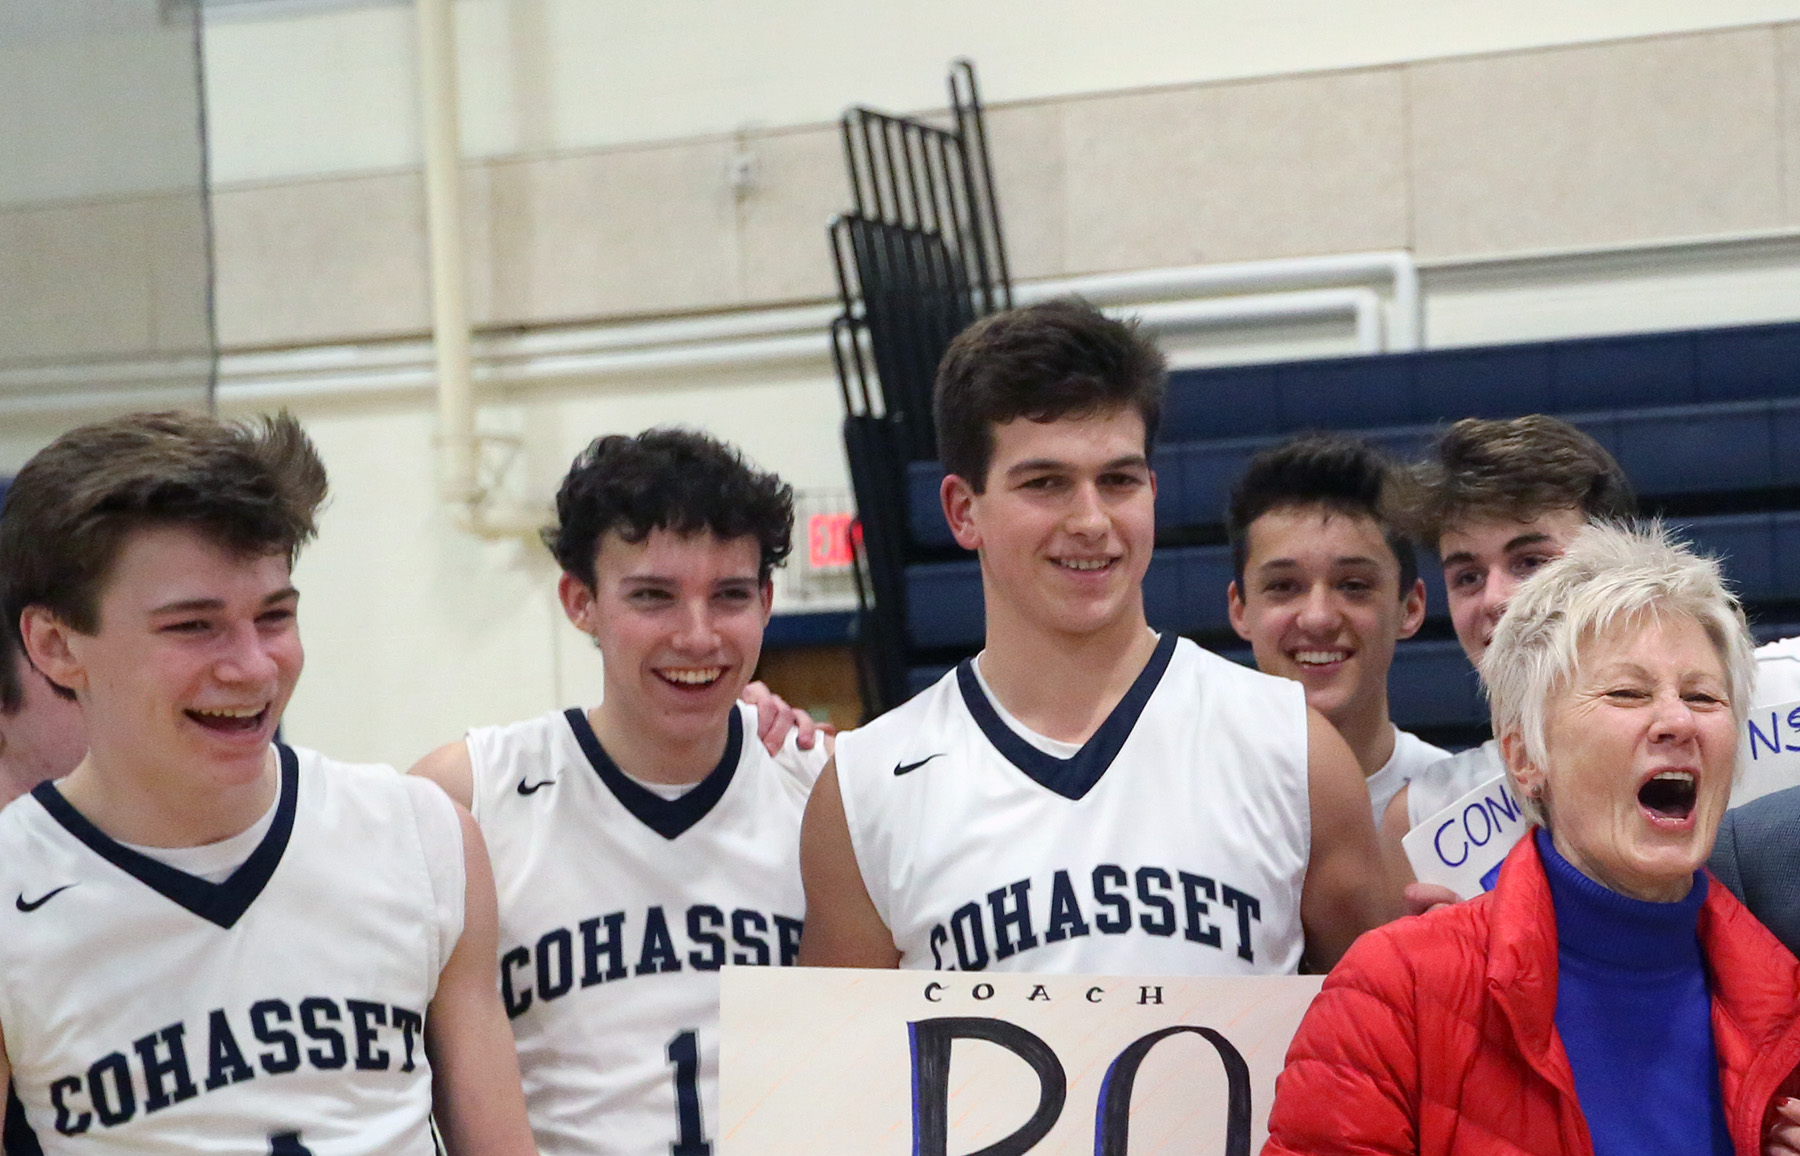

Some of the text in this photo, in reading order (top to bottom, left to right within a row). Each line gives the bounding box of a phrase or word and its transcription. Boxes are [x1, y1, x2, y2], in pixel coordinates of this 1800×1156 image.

[1434, 784, 1522, 868] CON
[930, 864, 1262, 971] COHASSET
[924, 982, 1165, 1005] COACH
[50, 996, 422, 1137] COHASSET
